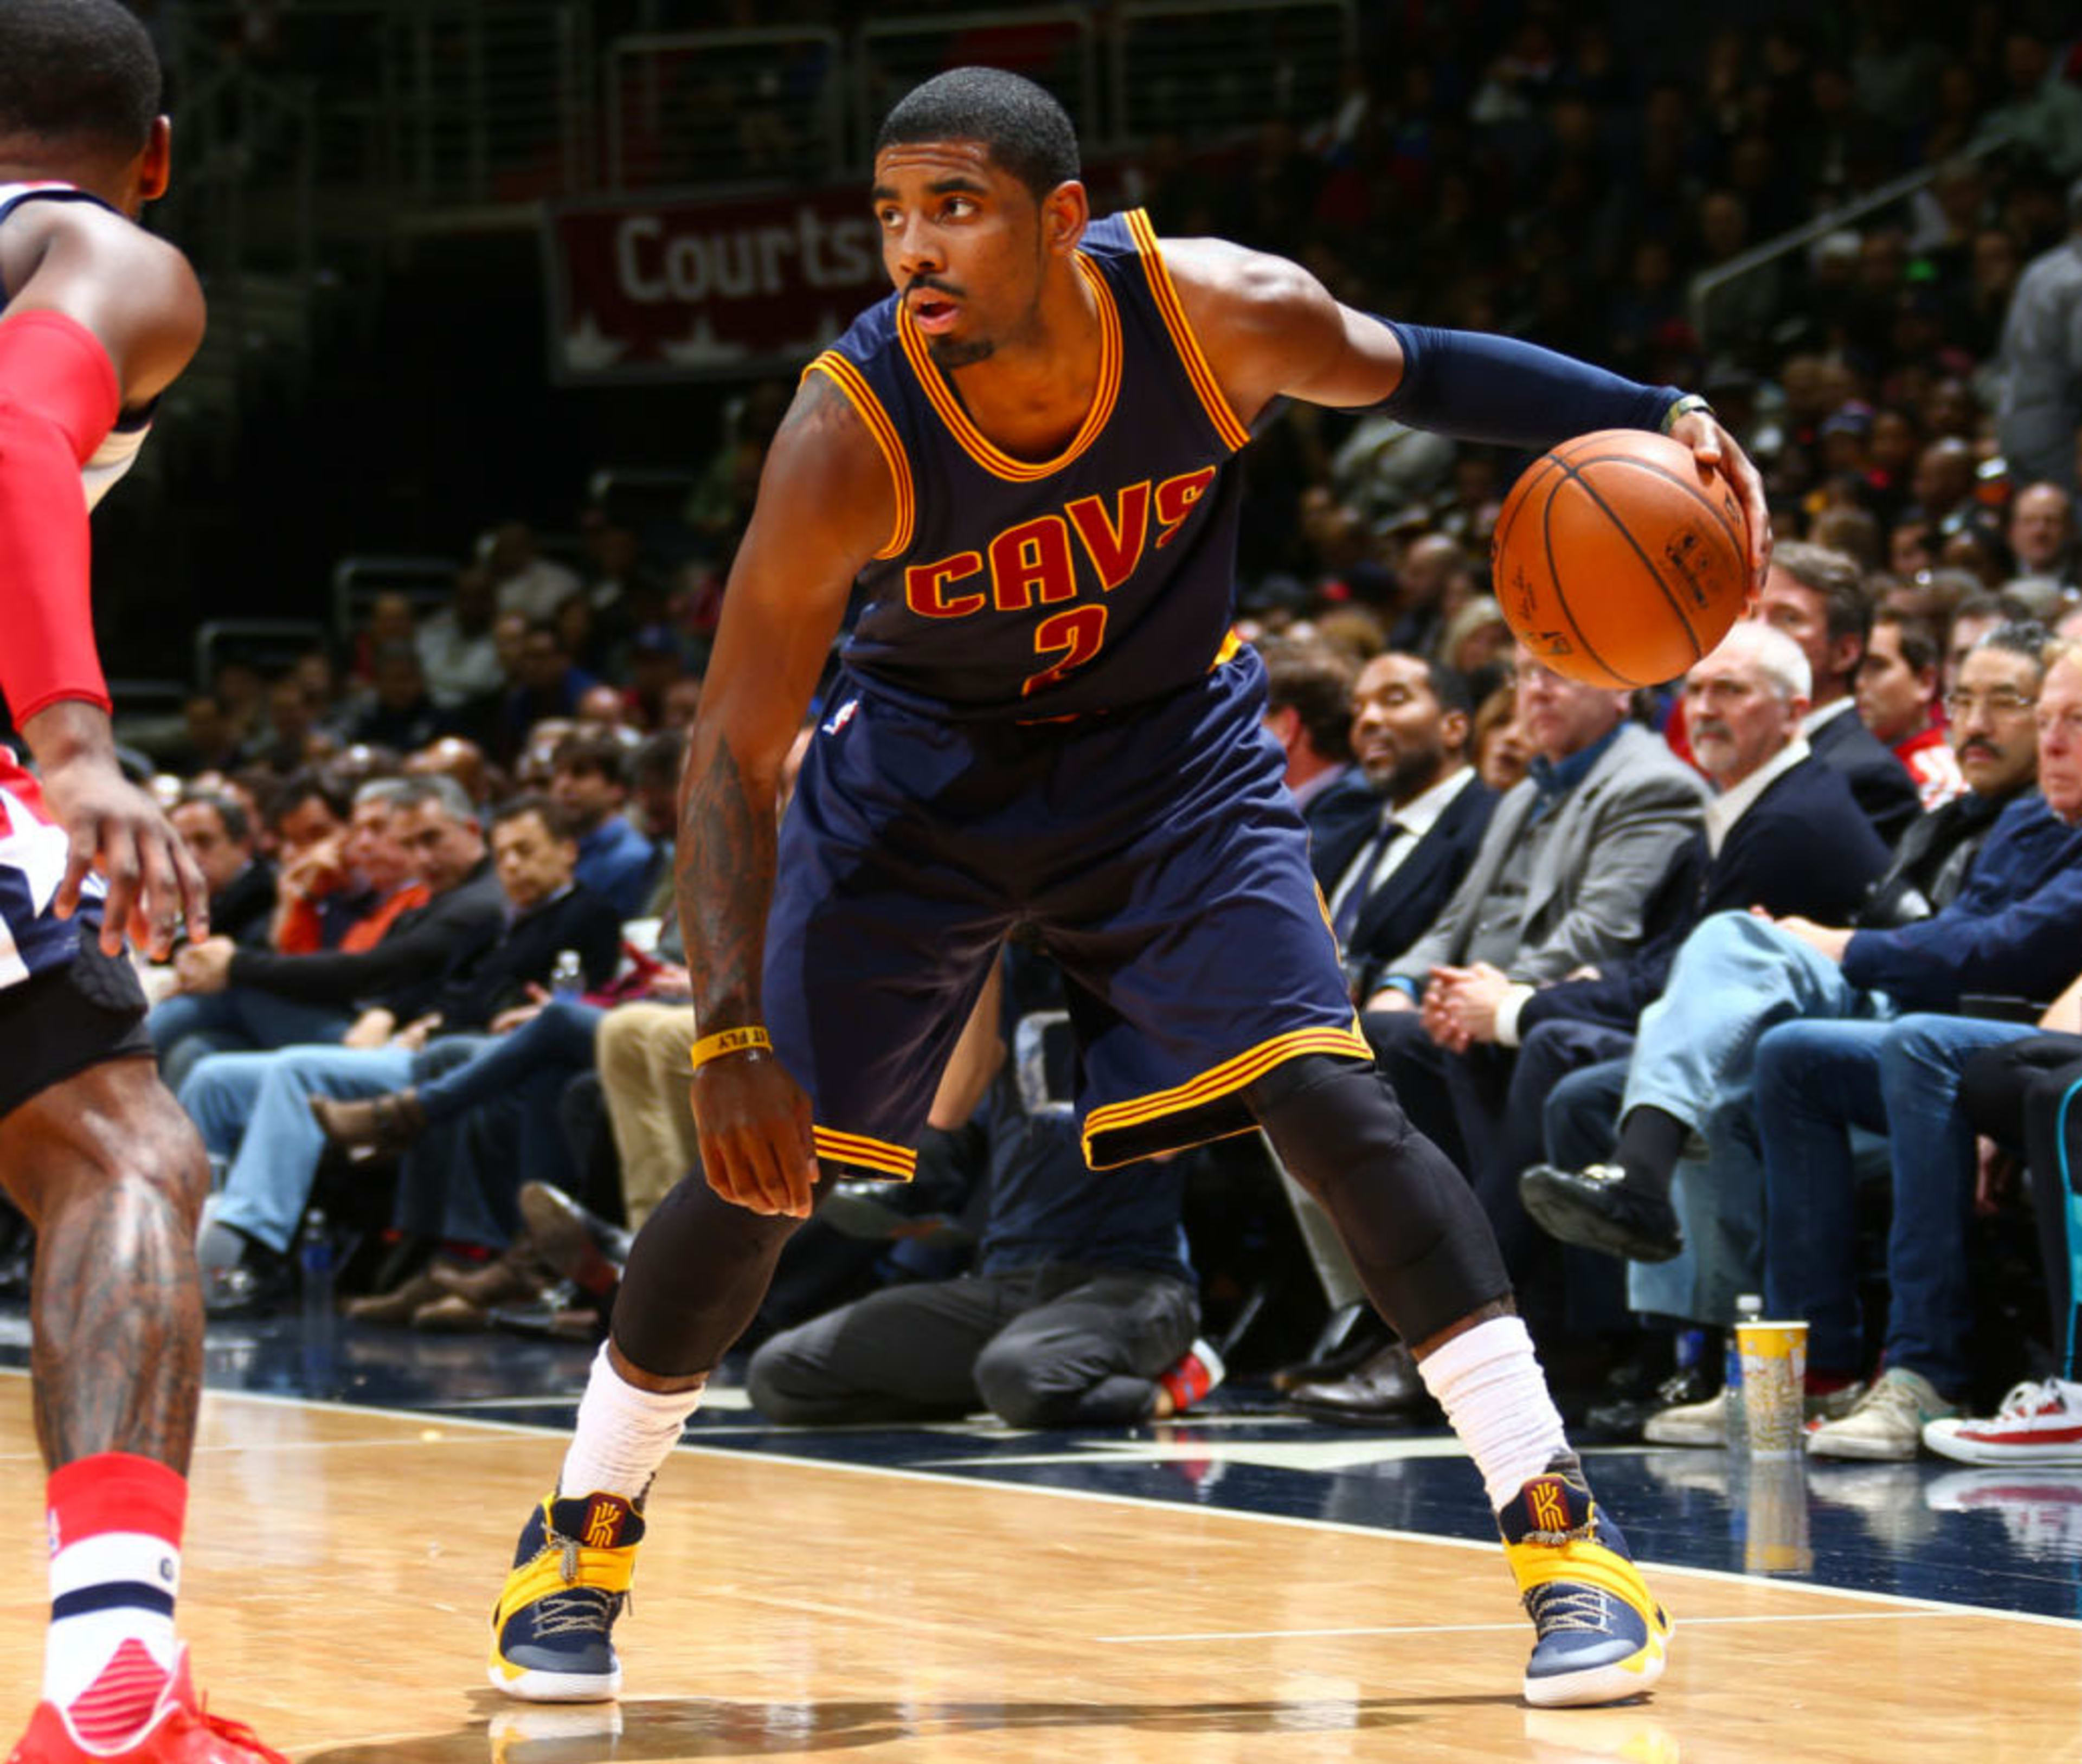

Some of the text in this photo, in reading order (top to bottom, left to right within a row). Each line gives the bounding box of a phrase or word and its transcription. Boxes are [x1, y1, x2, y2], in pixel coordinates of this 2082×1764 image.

[617, 206, 889, 301] Courts
[905, 466, 1216, 617] CAVS
[1021, 604, 1108, 696] 2
[718, 1030, 748, 1049] FLY
